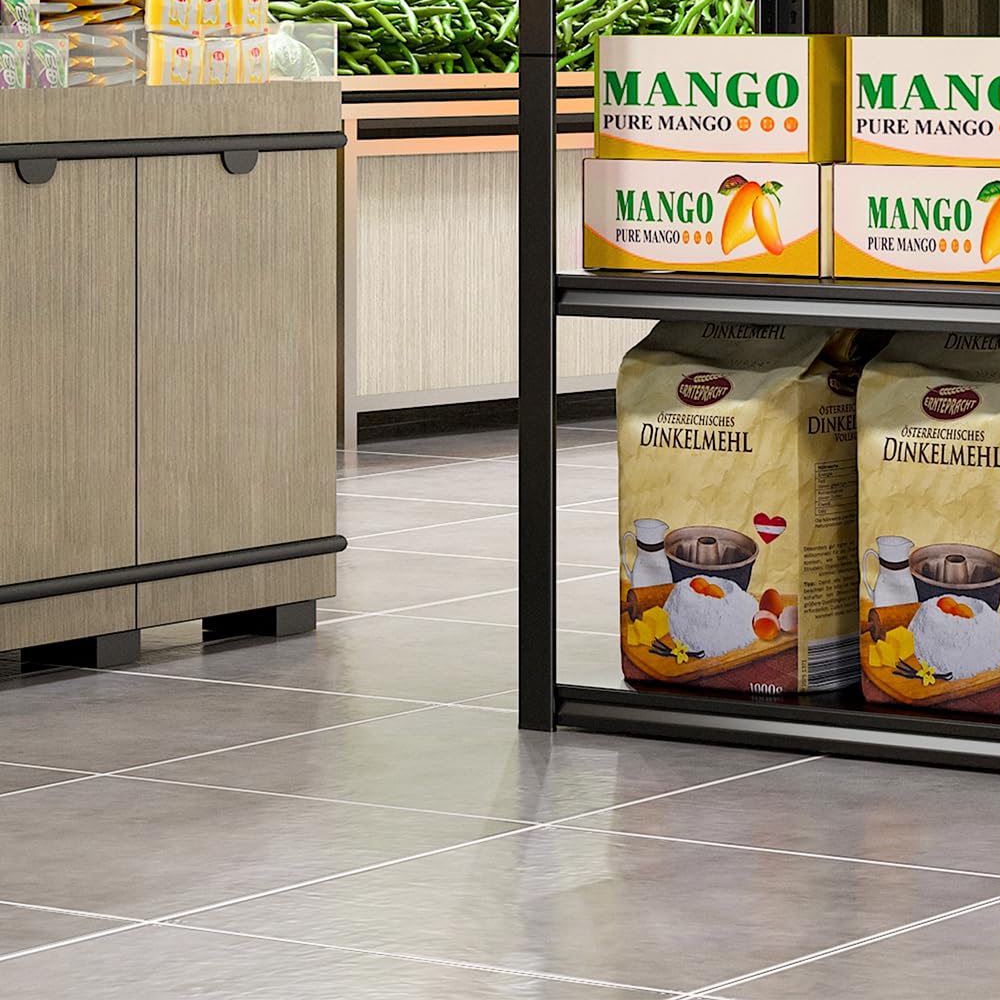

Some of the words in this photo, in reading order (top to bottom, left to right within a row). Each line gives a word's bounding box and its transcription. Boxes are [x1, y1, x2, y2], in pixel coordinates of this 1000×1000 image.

[602, 71, 800, 108] MANGO
[603, 115, 652, 130] PURE
[659, 115, 732, 131] MANGO
[856, 118, 909, 135] PURE
[915, 119, 994, 136] MANGO
[616, 190, 713, 224] MANGO
[867, 196, 972, 232] MANGO
[616, 229, 641, 243] PURE
[643, 229, 680, 244] MANGO
[867, 237, 894, 251] PURE
[896, 237, 937, 252] MANGO
[702, 323, 785, 340] DINKELMEHL
[657, 412, 735, 427] ÖSTERREICHISCHES
[640, 423, 753, 453] DINKELMEHL
[901, 425, 985, 442] ÖSTERREICHISCHES
